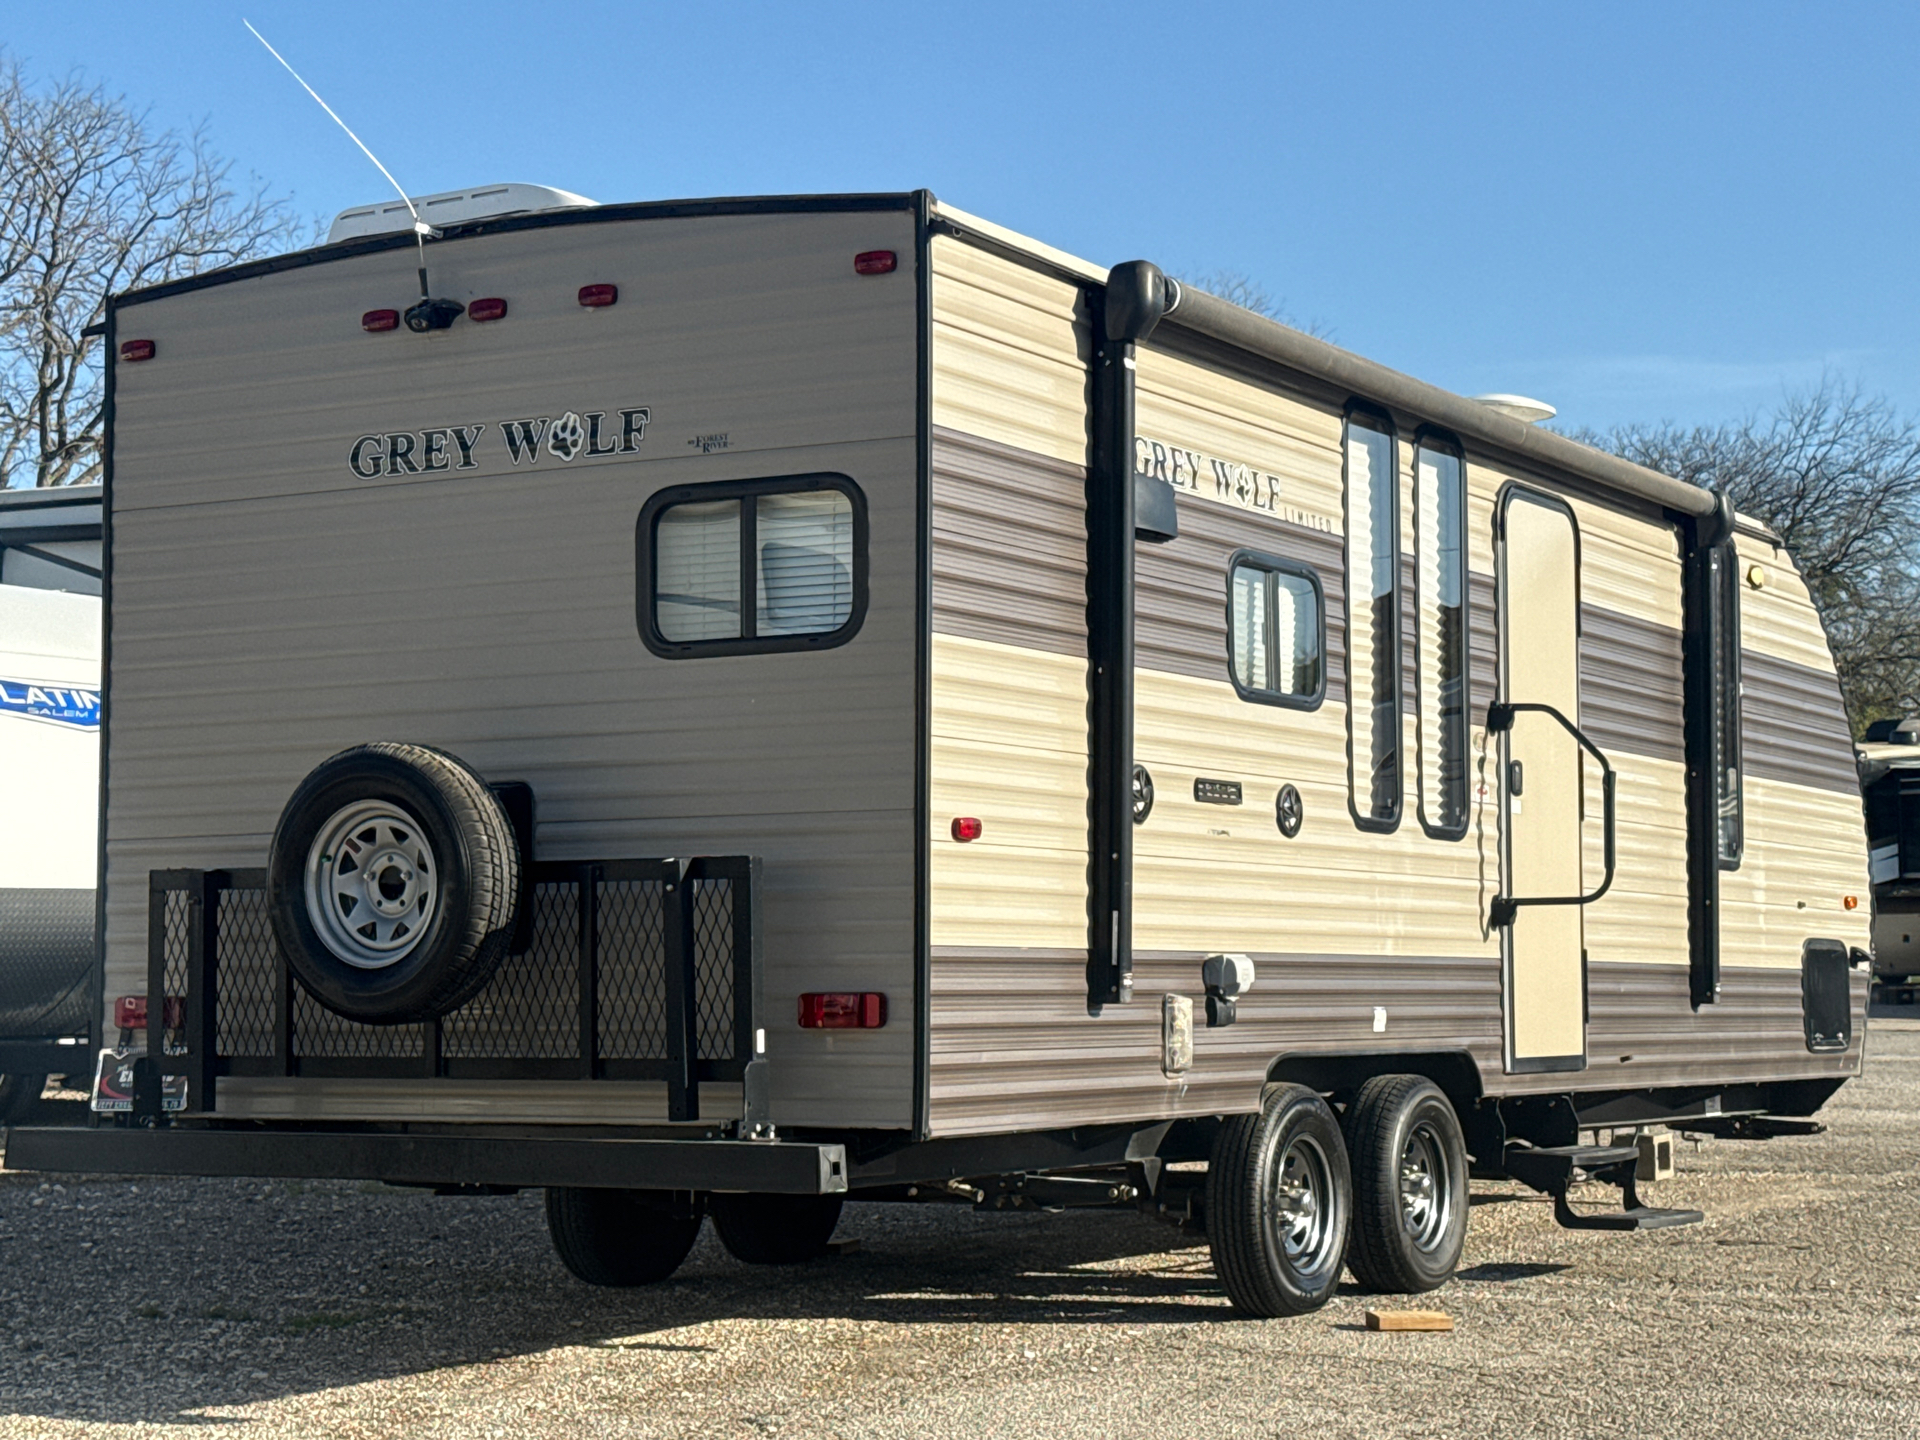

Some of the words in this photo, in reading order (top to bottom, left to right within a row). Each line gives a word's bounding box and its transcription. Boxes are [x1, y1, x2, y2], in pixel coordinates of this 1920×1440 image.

[349, 425, 485, 479] GREY
[1135, 436, 1202, 490] GREY
[1284, 507, 1332, 533] LIMITED
[27, 706, 88, 718] SALEM
